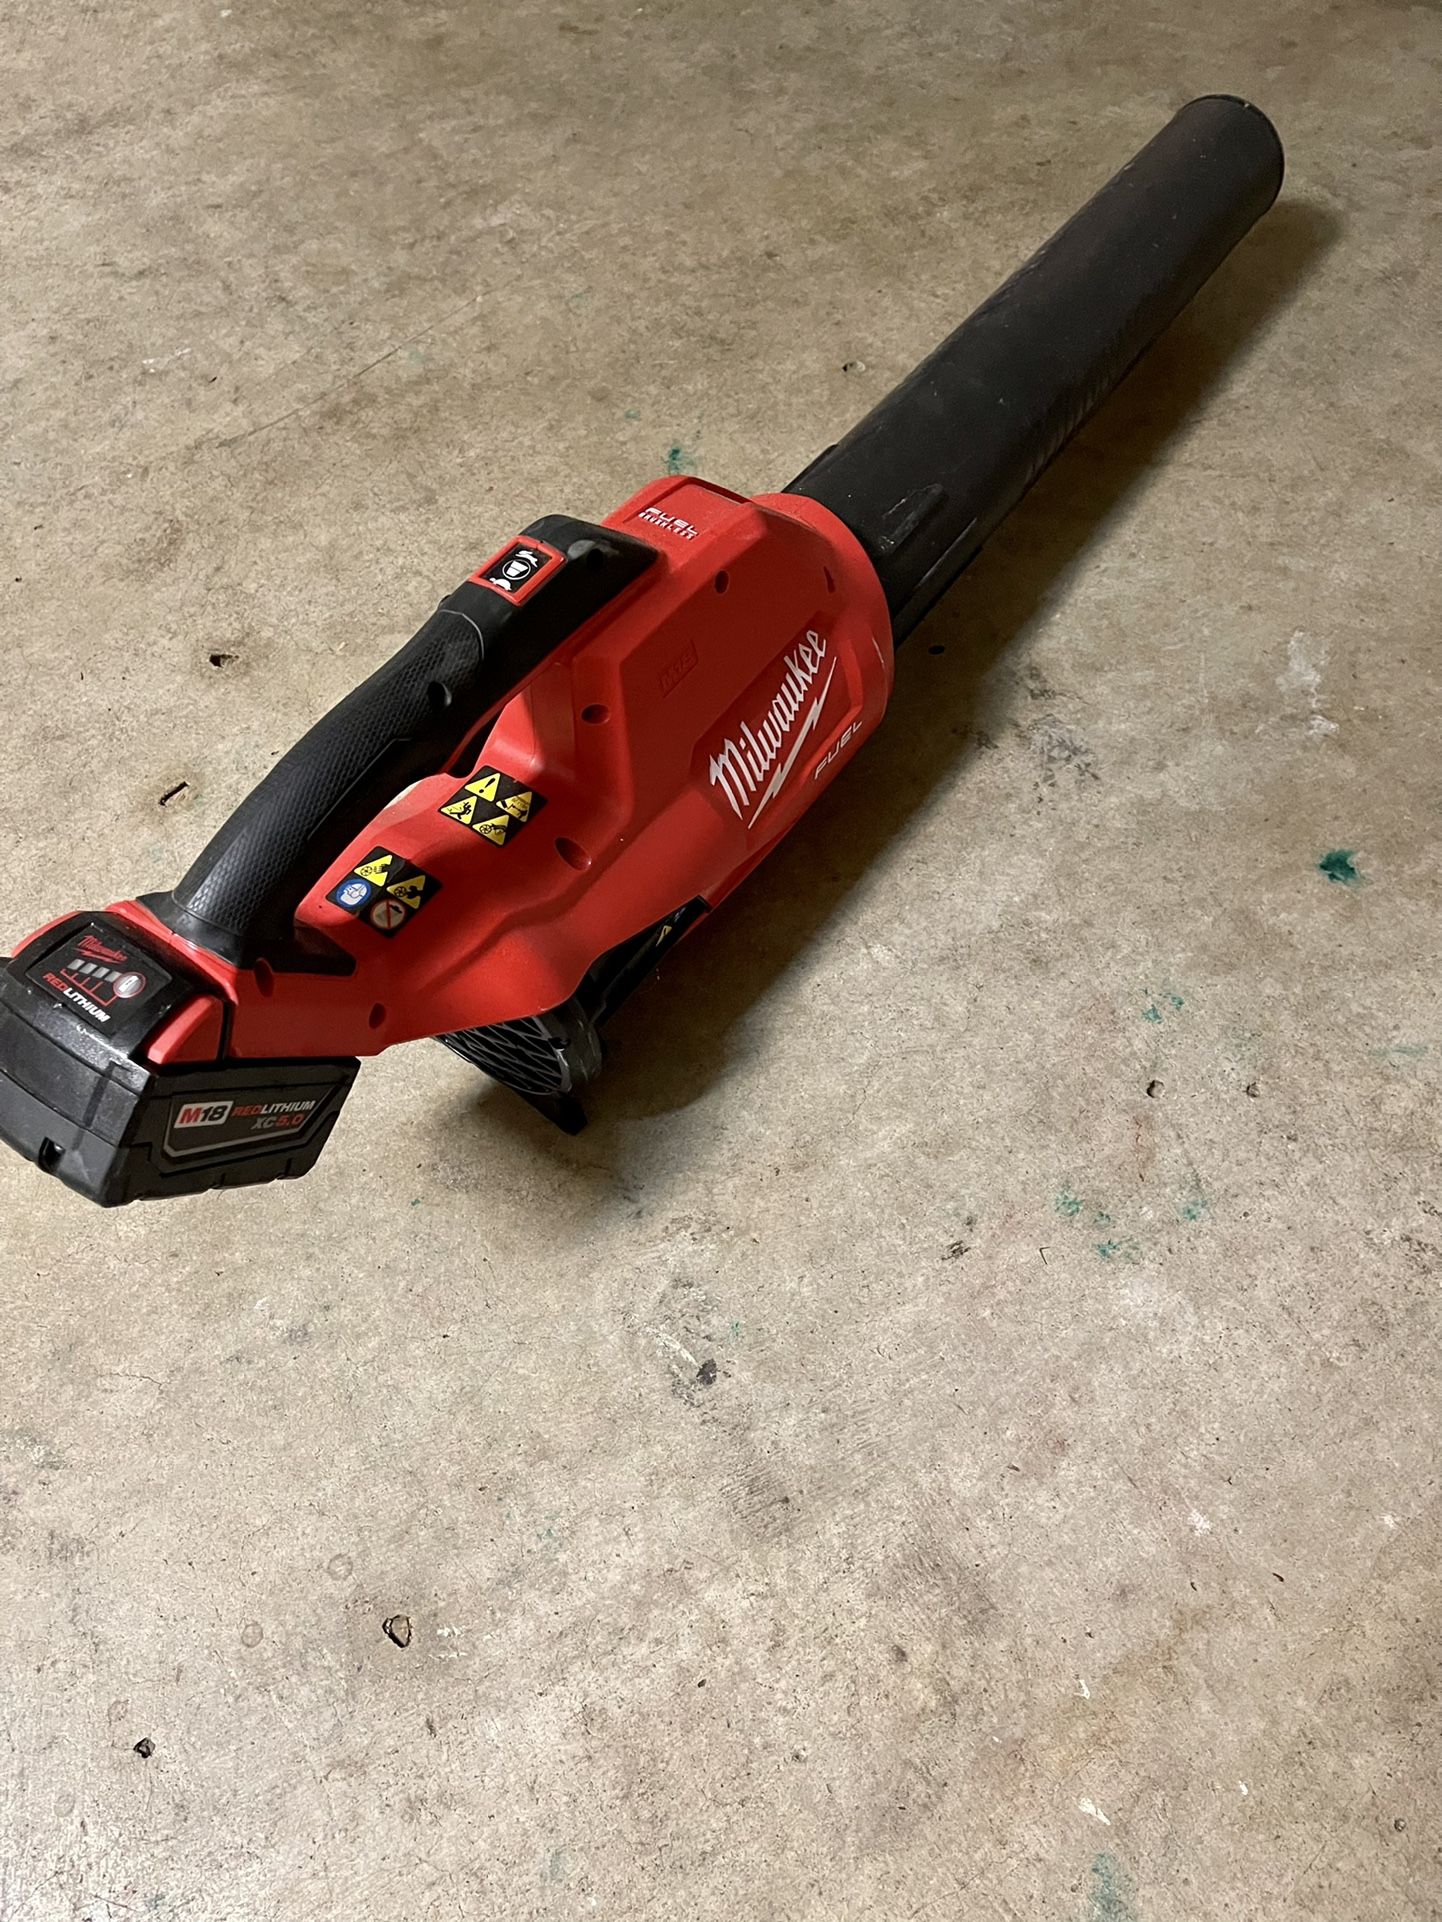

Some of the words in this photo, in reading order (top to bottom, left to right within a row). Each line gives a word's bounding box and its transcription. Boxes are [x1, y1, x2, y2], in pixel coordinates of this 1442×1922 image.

[645, 507, 699, 536] FUEL
[709, 630, 827, 820] Milwaukee
[814, 721, 863, 779] FUEL
[42, 972, 111, 1022] REDLITHIUM
[178, 1105, 229, 1124] M18
[231, 1100, 316, 1117] REDLITHIUM
